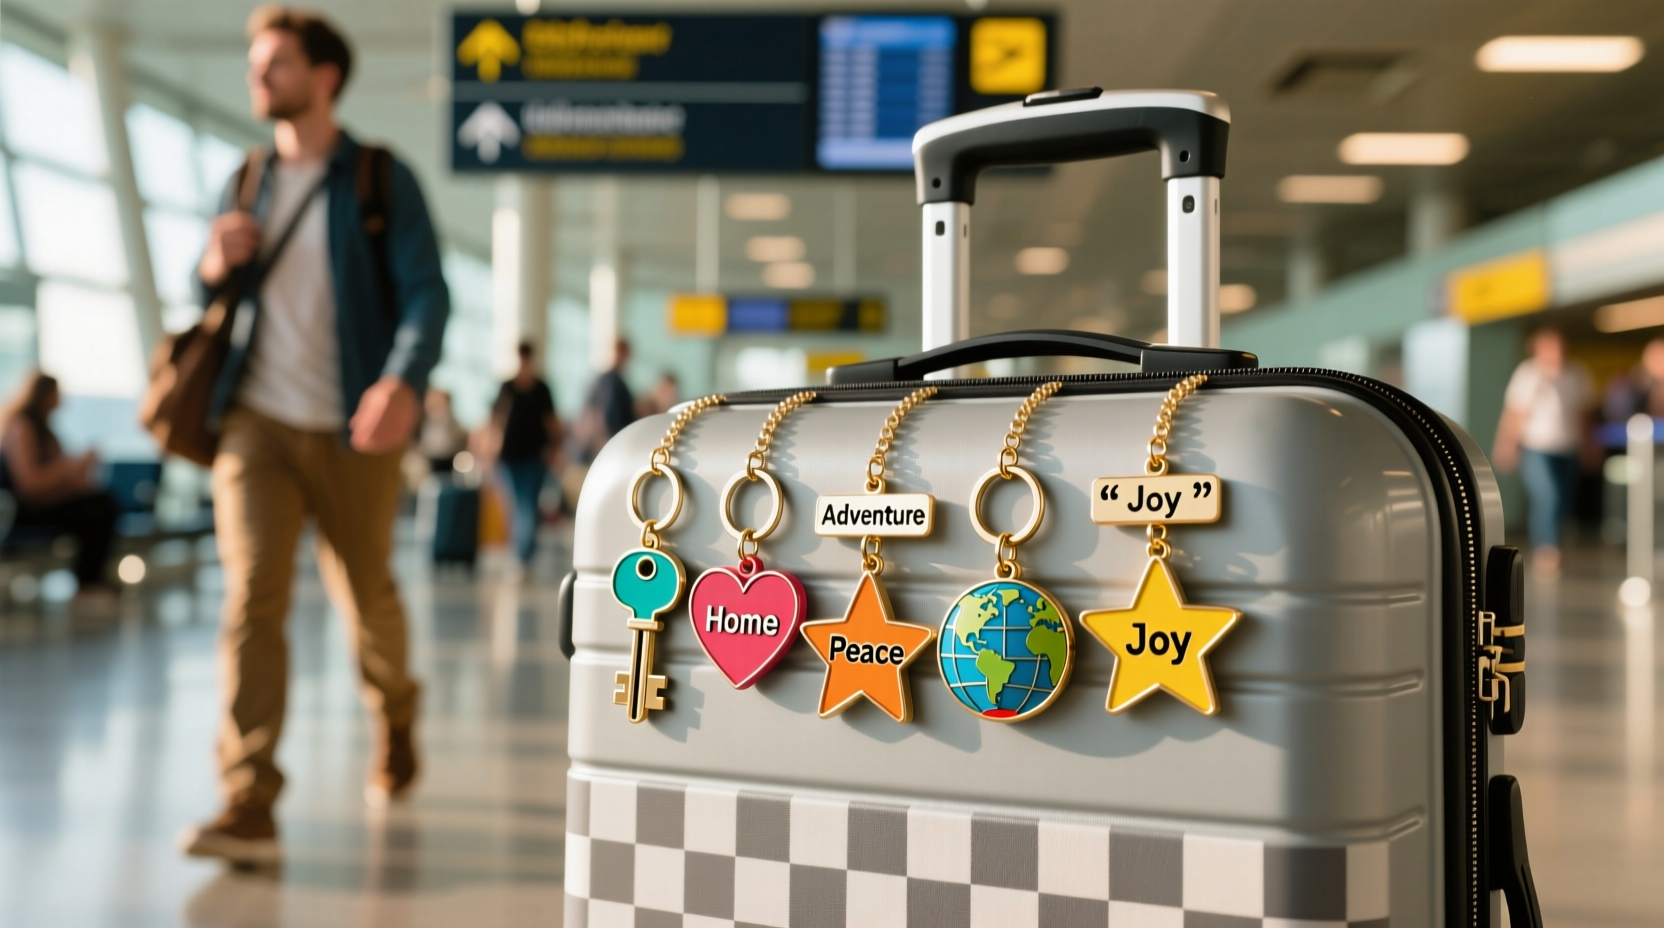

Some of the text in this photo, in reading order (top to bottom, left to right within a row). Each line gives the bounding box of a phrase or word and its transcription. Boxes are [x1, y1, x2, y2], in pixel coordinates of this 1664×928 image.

[821, 503, 926, 526] Adventure
[705, 604, 780, 637] Home
[829, 635, 905, 666] Peace
[1125, 622, 1192, 666] Joy
